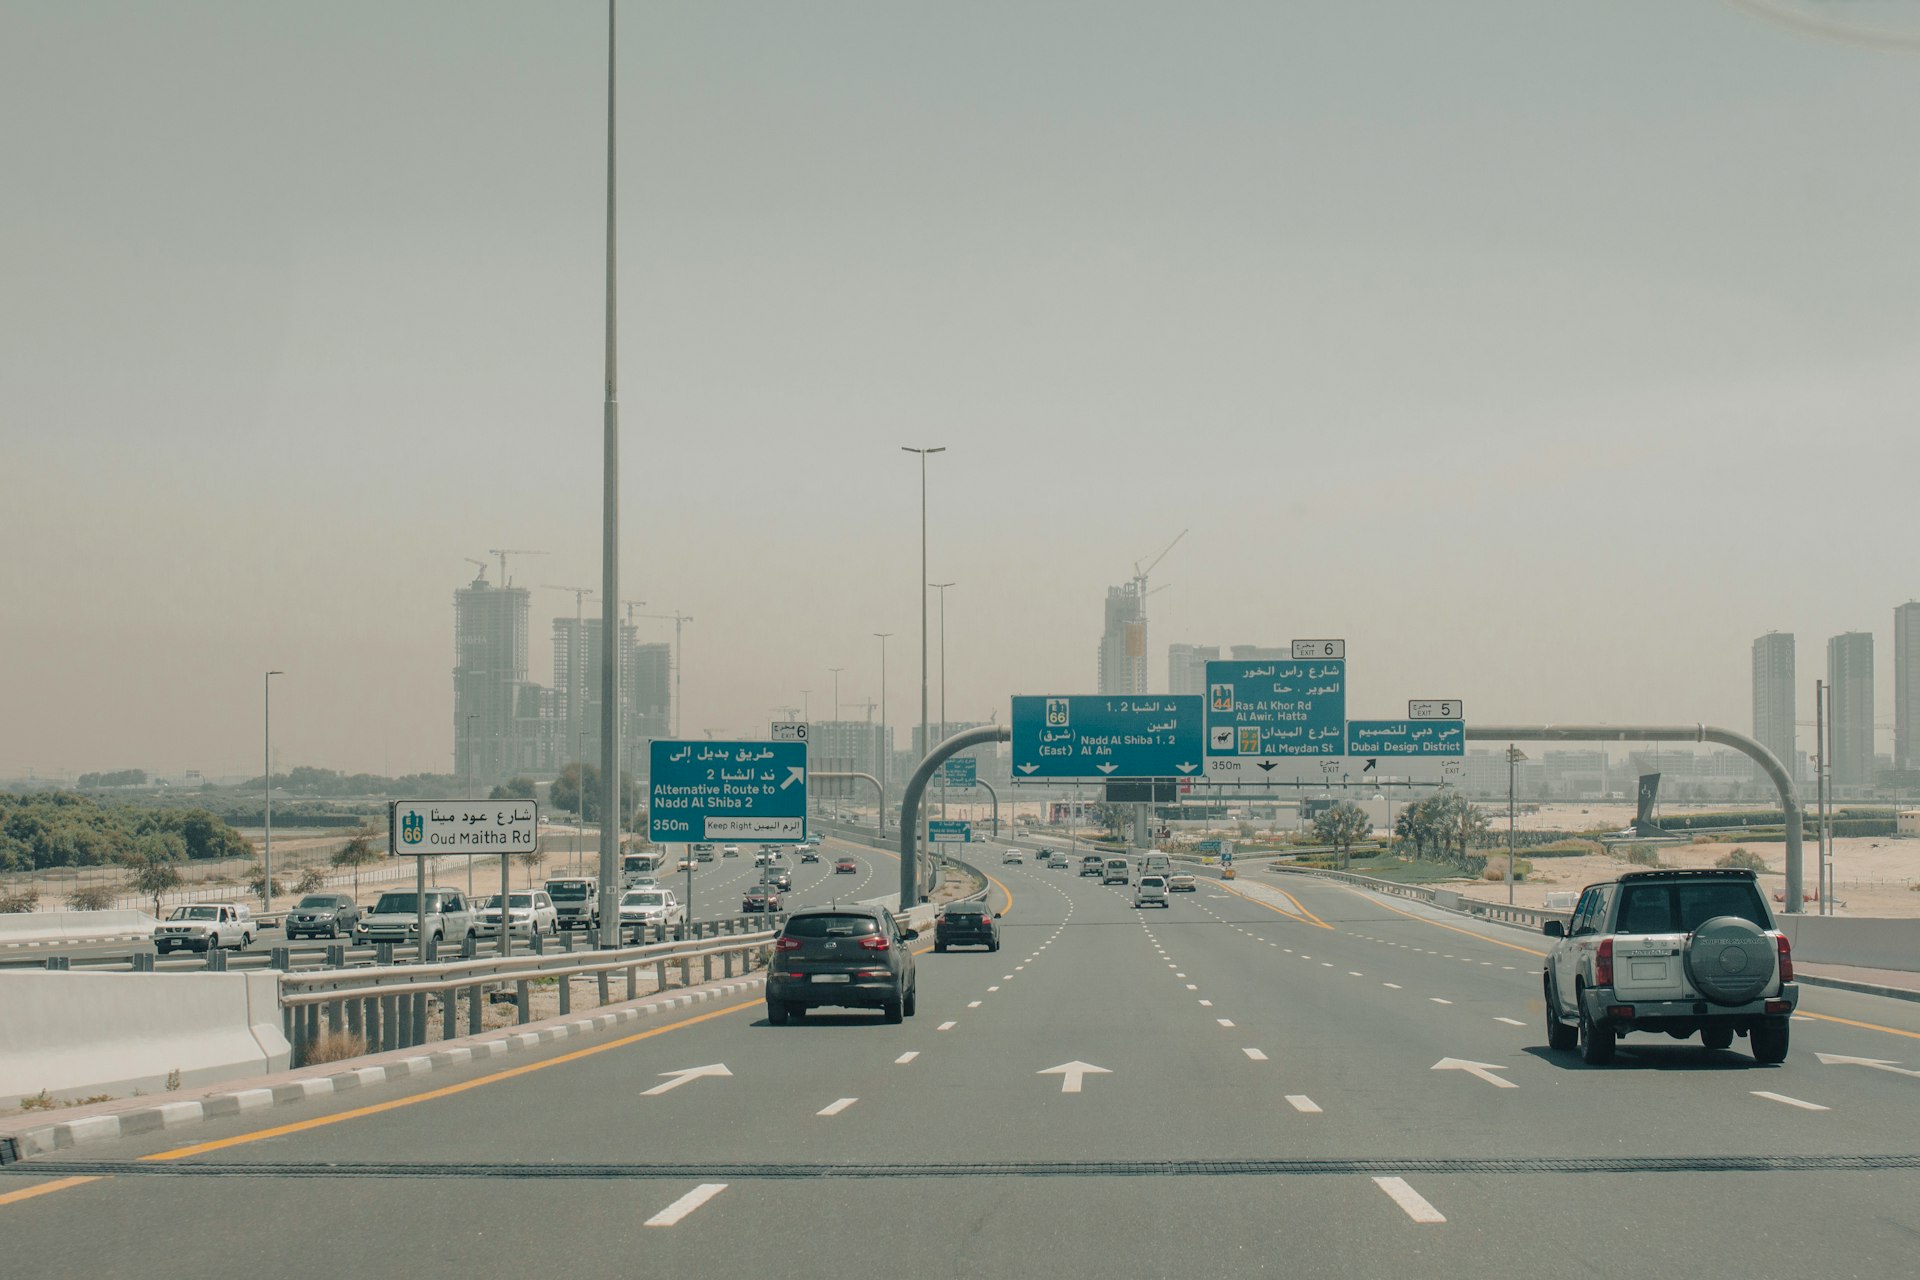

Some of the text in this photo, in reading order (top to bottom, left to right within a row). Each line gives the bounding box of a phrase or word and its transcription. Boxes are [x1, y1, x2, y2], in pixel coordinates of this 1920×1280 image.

[1324, 643, 1334, 656] 6
[1242, 665, 1340, 679] شارع راس الخور
[1273, 682, 1293, 693] حتا
[1305, 682, 1340, 696] العوير
[1132, 701, 1160, 714] الشبا
[1164, 702, 1177, 712] ند
[1214, 698, 1231, 710] 44
[1235, 701, 1312, 711] Ras Al Khor Rd
[1413, 703, 1432, 711] مخرج
[1441, 703, 1451, 716] 5
[1049, 712, 1066, 723] 66
[1235, 712, 1248, 721] Al
[1277, 711, 1308, 721] Hatta
[773, 724, 796, 732] مخرج
[796, 725, 806, 738] 6
[1147, 719, 1177, 732] العين
[1261, 726, 1340, 740] شارع الميدان
[1359, 724, 1461, 741] حي دبي للتصميم
[1081, 736, 1108, 745] Nadd
[1110, 736, 1121, 745] Al
[1124, 735, 1153, 745] Shiba
[1242, 740, 1257, 752] 77
[1038, 745, 1073, 757] (East)
[1080, 746, 1112, 755] Al Ain
[1264, 743, 1334, 755] Al Meydan St
[1351, 741, 1461, 753] Dubai Design District
[669, 745, 775, 763] طريق بديل إلى
[1211, 761, 1242, 770] 350m
[706, 767, 776, 782] ند الشبا 2
[654, 784, 776, 795] Alternative Route to
[654, 797, 753, 809] Nadd Al Shiba 2
[430, 808, 532, 826] شارع عود ميثا
[653, 819, 689, 831] 350m
[707, 820, 752, 832] Keep Right
[753, 821, 800, 834] إلزم اليمين
[404, 827, 422, 843] 66
[430, 830, 531, 845] Oud Maitha Rd
